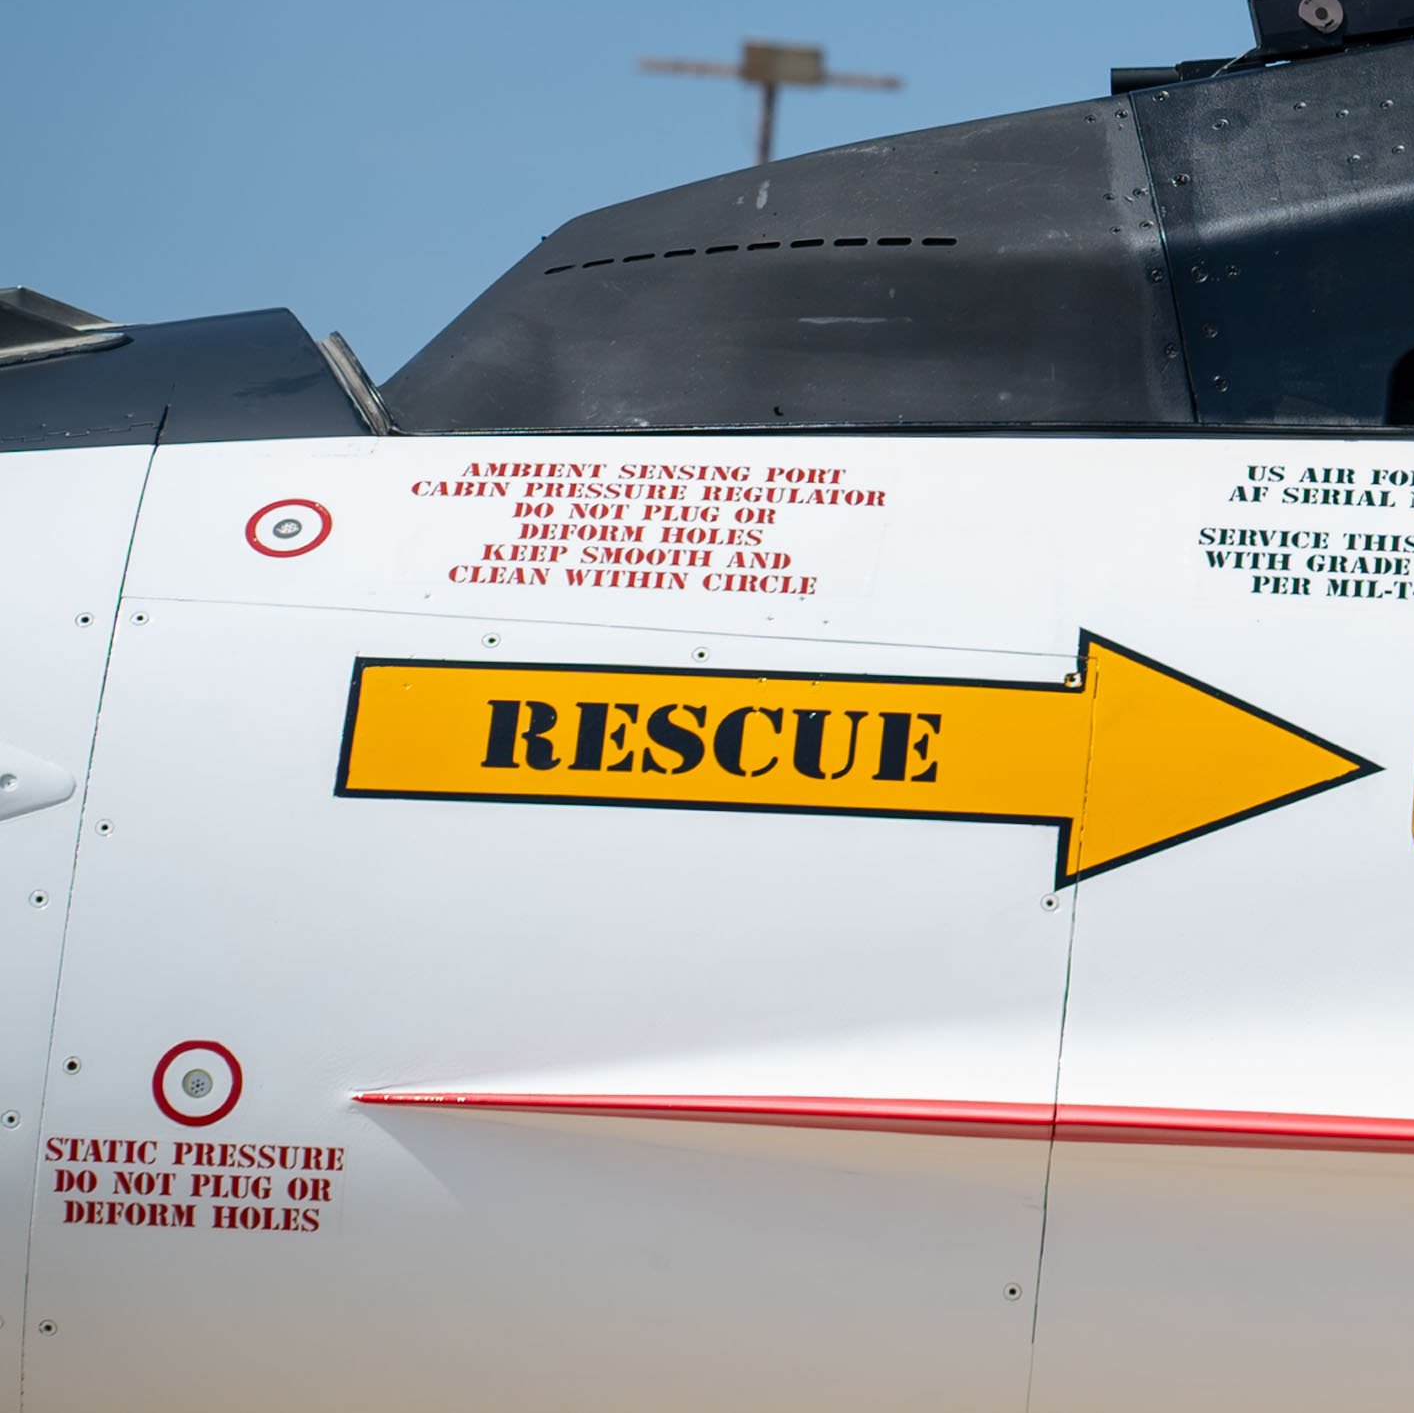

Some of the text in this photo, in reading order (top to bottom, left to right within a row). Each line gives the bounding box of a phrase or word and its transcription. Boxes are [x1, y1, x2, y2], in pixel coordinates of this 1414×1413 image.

[464, 462, 841, 484] AMBIENT SENSING PORT
[1248, 465, 1285, 482] US
[1299, 467, 1355, 484] AIR
[412, 481, 886, 506] CABIN PRESSURE REGULATOR
[1228, 486, 1268, 502] AF
[1282, 487, 1396, 507] SERIAL
[514, 502, 776, 524] DO NOT PLUG OR
[520, 523, 762, 545] DEFORM HOLES
[1198, 528, 1329, 549] SERVICE
[483, 544, 792, 569] KEEP SMOOTH AND
[1205, 550, 1292, 571] WITH
[1306, 554, 1410, 576] GRADE
[449, 566, 816, 594] CLEAN WITHIN CIRCLE
[1251, 575, 1310, 595] PER
[481, 700, 941, 782] RESCUE
[46, 1138, 344, 1171] STATIC PRESSURE
[56, 1168, 331, 1202] DO NOT PLUG OR
[66, 1200, 320, 1232] DEFORM HOLES
